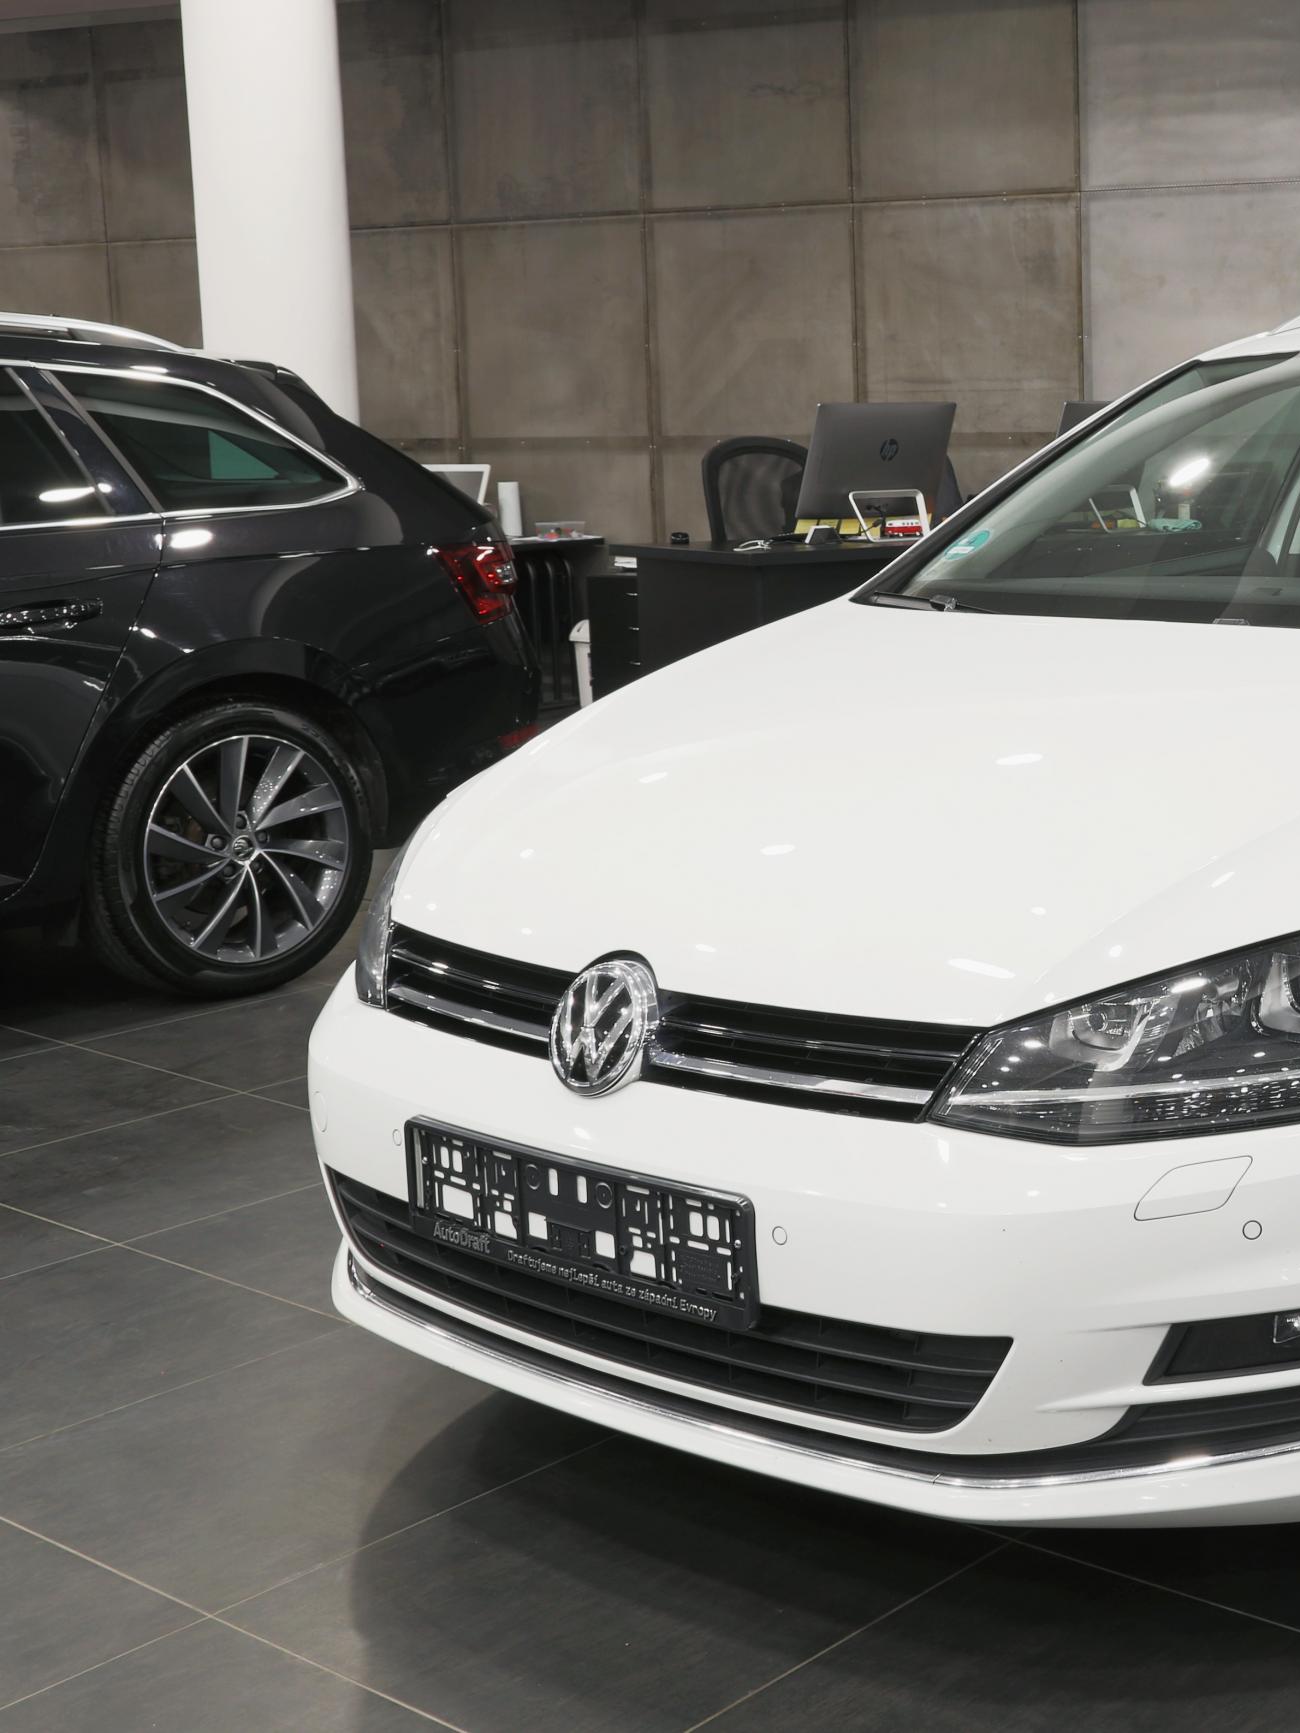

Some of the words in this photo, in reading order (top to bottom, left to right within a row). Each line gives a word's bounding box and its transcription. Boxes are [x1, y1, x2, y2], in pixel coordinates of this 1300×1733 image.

[880, 438, 899, 462] hp
[433, 1221, 490, 1254] AutoDraft
[601, 1279, 623, 1294] auta
[625, 1286, 636, 1297] ze
[638, 1288, 678, 1309] západní
[679, 1298, 717, 1321] Evropy
